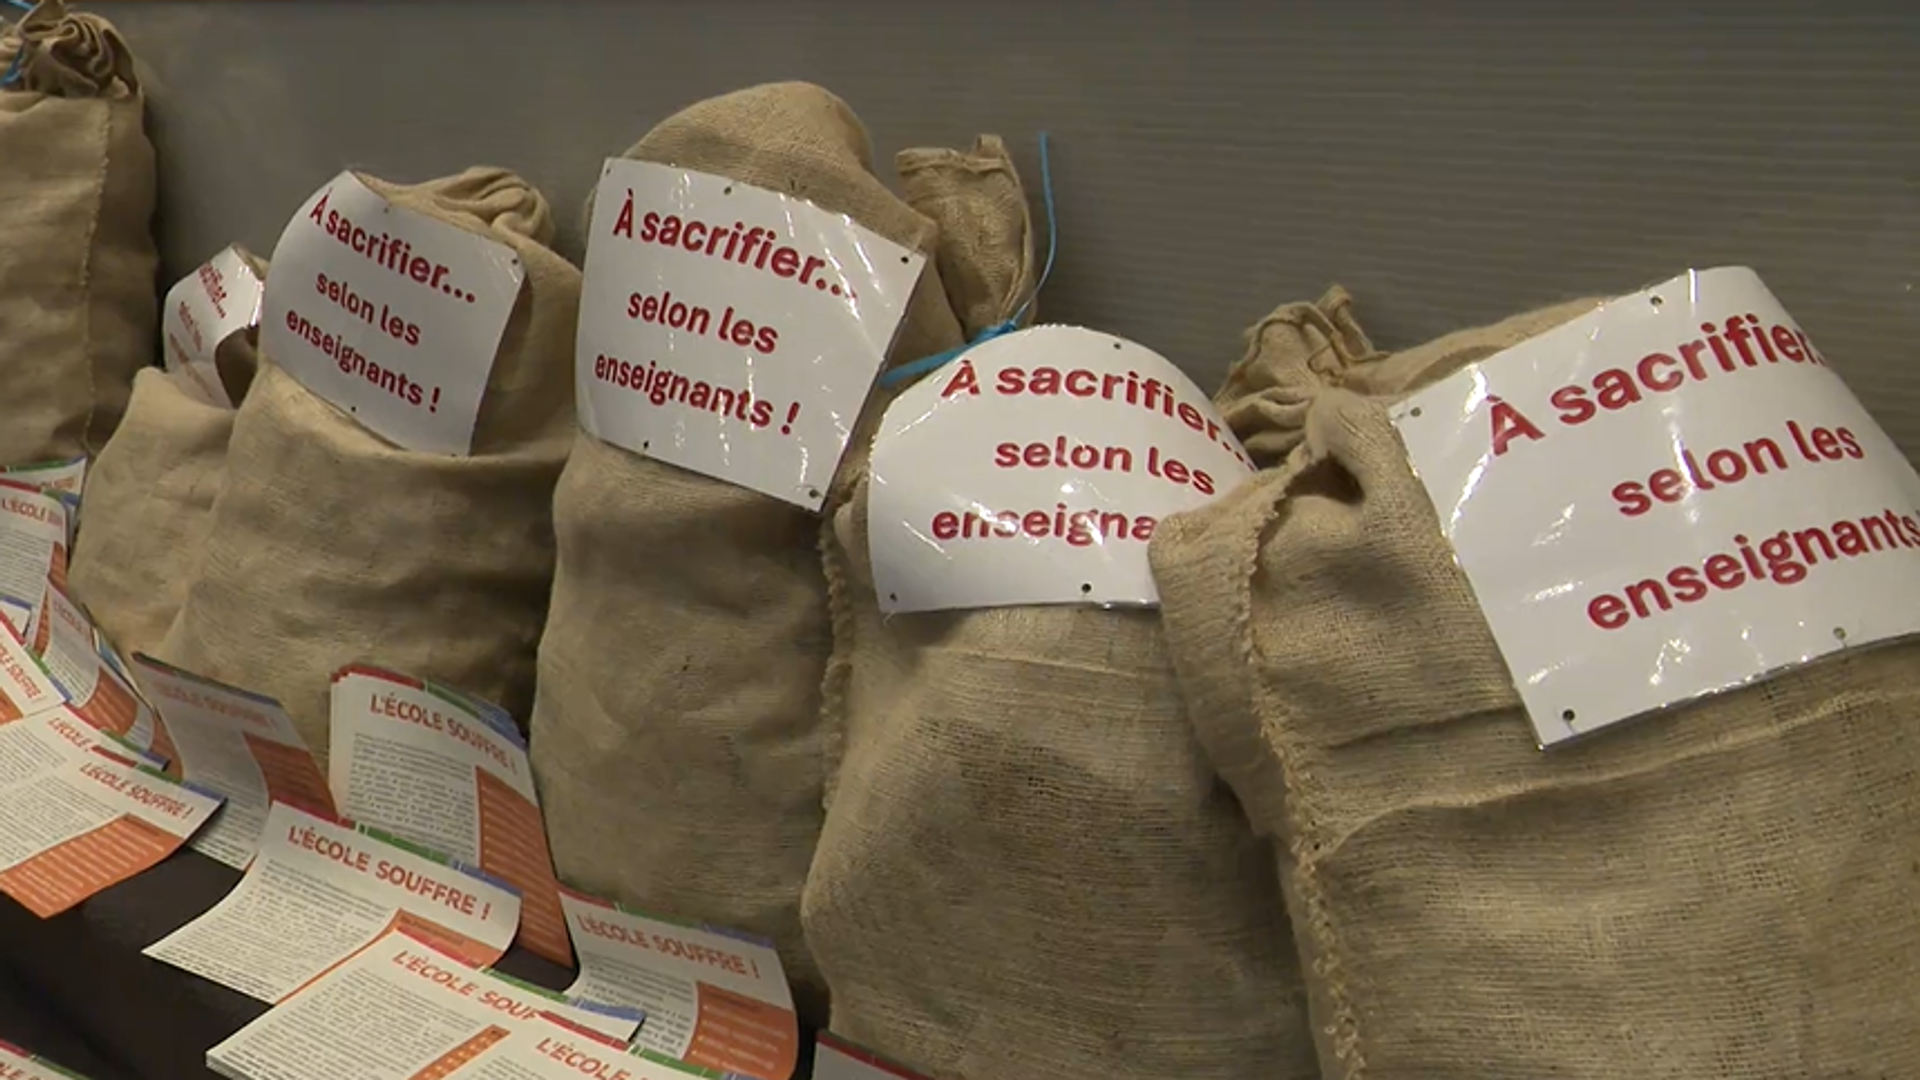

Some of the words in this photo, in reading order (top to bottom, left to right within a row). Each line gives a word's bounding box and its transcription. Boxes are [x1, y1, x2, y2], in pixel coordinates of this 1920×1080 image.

[309, 187, 333, 226] À
[326, 209, 476, 304] sacrifier...
[612, 188, 635, 238] À
[640, 208, 858, 304] sacrifier...
[316, 272, 375, 322] selon
[380, 304, 421, 346] les
[627, 291, 711, 335] selon
[717, 306, 778, 354] les
[286, 309, 424, 407] enseignants
[428, 386, 441, 413] !
[594, 353, 774, 428] enseignants
[780, 402, 801, 435] !
[940, 358, 982, 398] À
[1485, 394, 1546, 456] À
[994, 435, 1133, 473] selon
[1146, 446, 1216, 496] les
[1611, 436, 1789, 517] selon
[1785, 419, 1865, 464] les
[931, 502, 1157, 548] enseigna
[1586, 508, 1920, 631] enseignants
[370, 693, 445, 732] L'ÉCOLE
[288, 826, 371, 872] L'ÉCOLE
[375, 860, 479, 915] SOUFFRE
[480, 902, 491, 920] !
[577, 914, 651, 949] L'ÉCOLE
[652, 935, 747, 976] SOUFFRE
[392, 950, 480, 996] L'ÉCOLE
[479, 991, 540, 1022] SOUF
[535, 1037, 633, 1080] L'ÉCOLE
